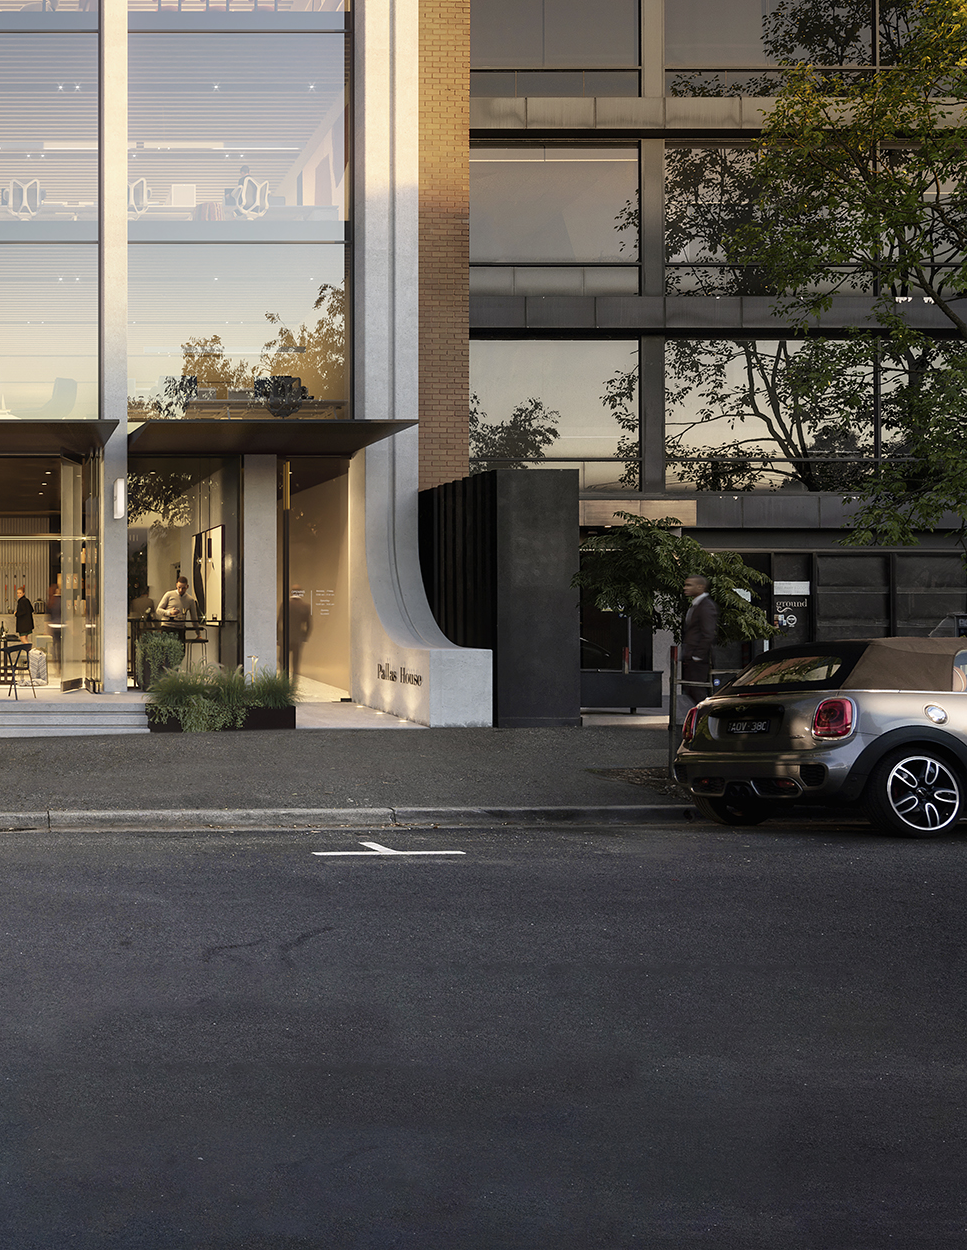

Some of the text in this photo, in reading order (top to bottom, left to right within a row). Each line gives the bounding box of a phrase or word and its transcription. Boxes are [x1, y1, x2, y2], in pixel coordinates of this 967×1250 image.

[776, 598, 807, 613] ground
[377, 662, 422, 686] Pallas House
